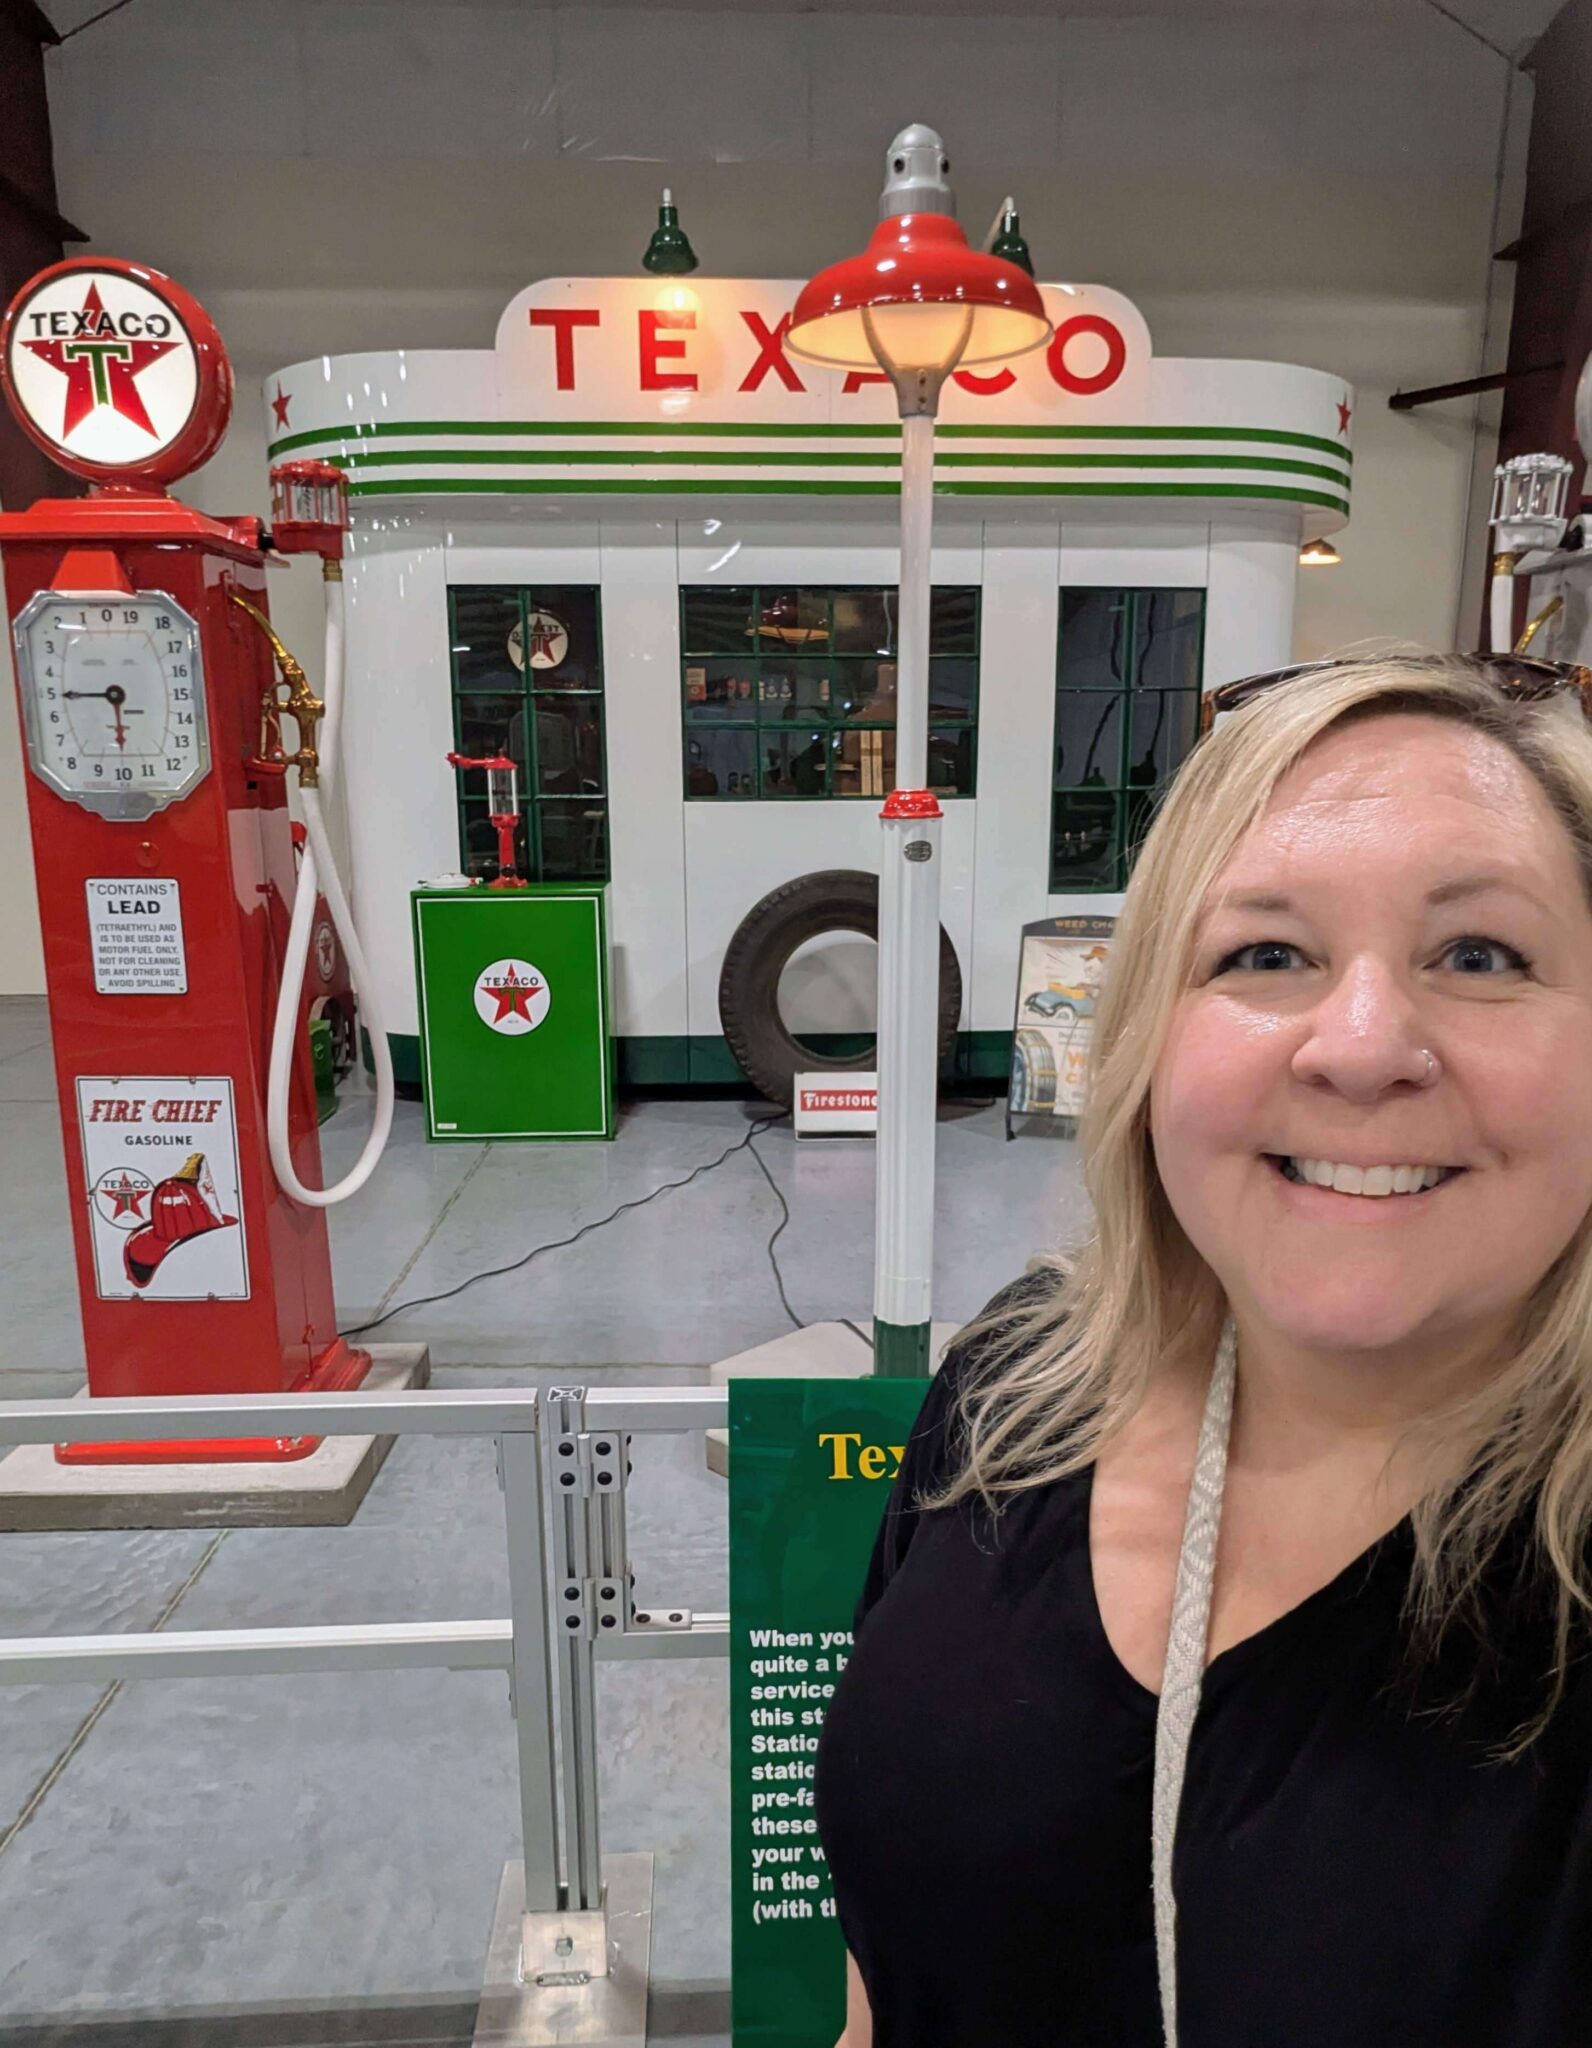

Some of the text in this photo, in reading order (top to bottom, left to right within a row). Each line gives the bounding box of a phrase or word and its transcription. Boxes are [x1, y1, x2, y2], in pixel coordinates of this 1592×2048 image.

[29, 311, 172, 338] TEXACO
[529, 309, 1126, 395] TEXO
[79, 612, 87, 624] 1
[101, 608, 112, 622] 0
[123, 610, 139, 624] 19
[155, 616, 170, 630] 18
[45, 641, 54, 654] 3
[168, 642, 182, 654] 17
[45, 666, 54, 678] 4
[172, 666, 187, 678] 16
[47, 688, 56, 700] 5
[174, 688, 189, 700] 15
[50, 711, 59, 723] 6
[178, 712, 192, 724] 14
[56, 735, 64, 746] 7
[175, 736, 190, 748] 13
[67, 758, 77, 770] 8
[94, 764, 104, 776] 9
[142, 764, 155, 776] 11
[166, 759, 181, 771] 12
[116, 768, 132, 780] 10
[97, 884, 168, 896] CONTAINS
[108, 900, 161, 914] LEAD
[96, 923, 176, 932] (TETRAETHYL) AND
[100, 934, 175, 942] IS TO BE USED AS
[98, 946, 130, 954] MOTOR
[132, 946, 153, 954] FUEL
[98, 957, 180, 965] NOT FOR CLEANING
[98, 968, 110, 976] OR
[113, 968, 130, 976] ANY
[132, 968, 161, 976] OTHER
[108, 979, 176, 987] AVOID SPILLING
[484, 976, 539, 986] TEXACO
[803, 1092, 878, 1109] Firestone
[88, 1099, 222, 1122] FIRE CHIEF
[124, 1135, 193, 1146] GASOLINE
[103, 1180, 150, 1189] TEXACO
[750, 1630, 813, 1647] When
[750, 1656, 808, 1678] quite
[816, 1658, 829, 1672] a
[750, 1681, 836, 1700] service
[750, 1707, 824, 1726] this st
[752, 1816, 818, 1836] these
[752, 1847, 804, 1868] your
[752, 1872, 774, 1891] in
[780, 1870, 820, 1890] the
[752, 1898, 813, 1924] (with
